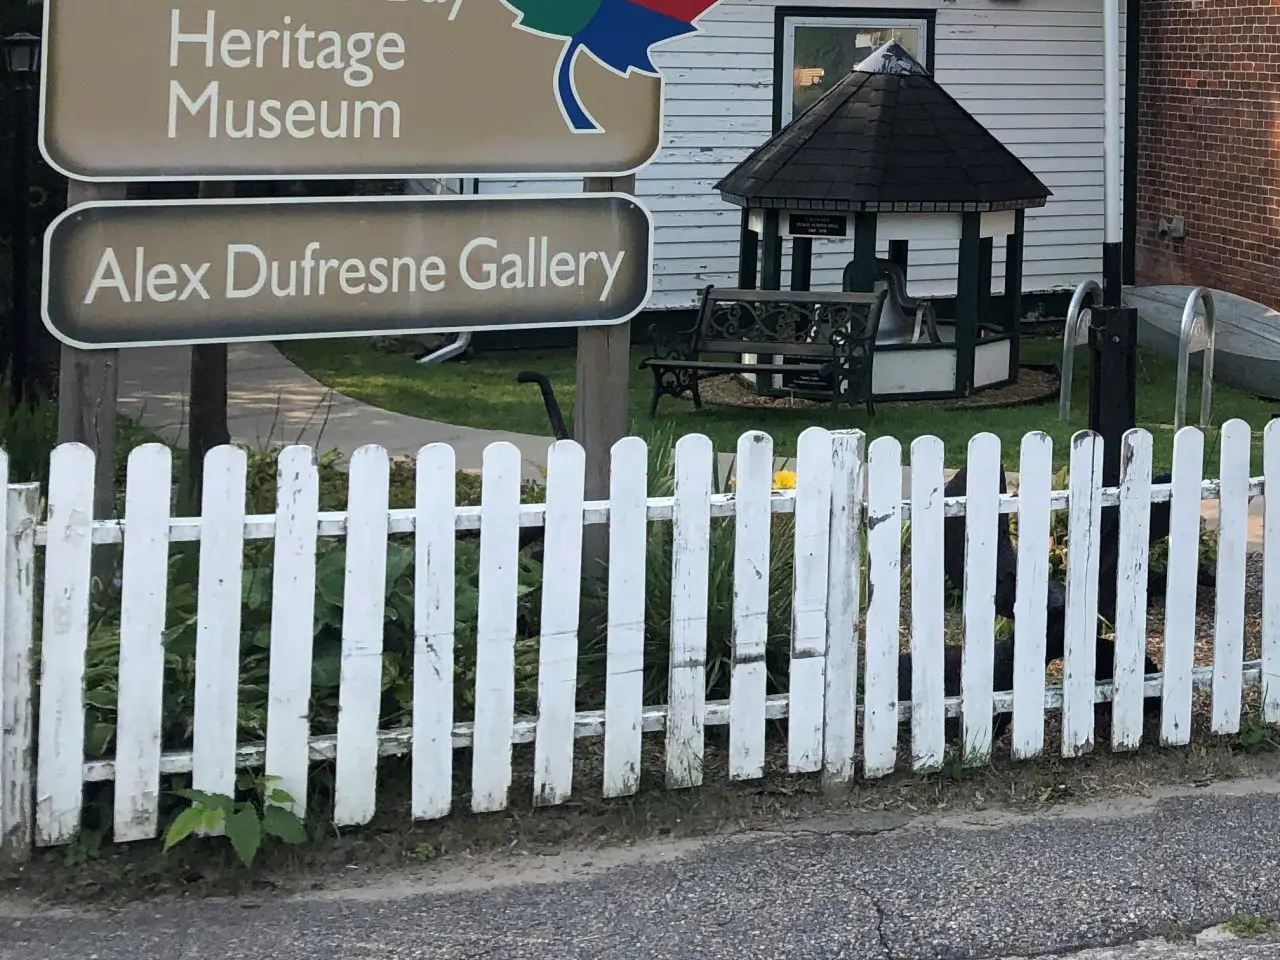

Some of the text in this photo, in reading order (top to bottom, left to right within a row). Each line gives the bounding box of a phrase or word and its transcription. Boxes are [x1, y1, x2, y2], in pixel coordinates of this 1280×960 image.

[169, 8, 407, 87] Heritage
[166, 80, 401, 139] Museum
[84, 235, 626, 304] Alex Dufresne Gallery
